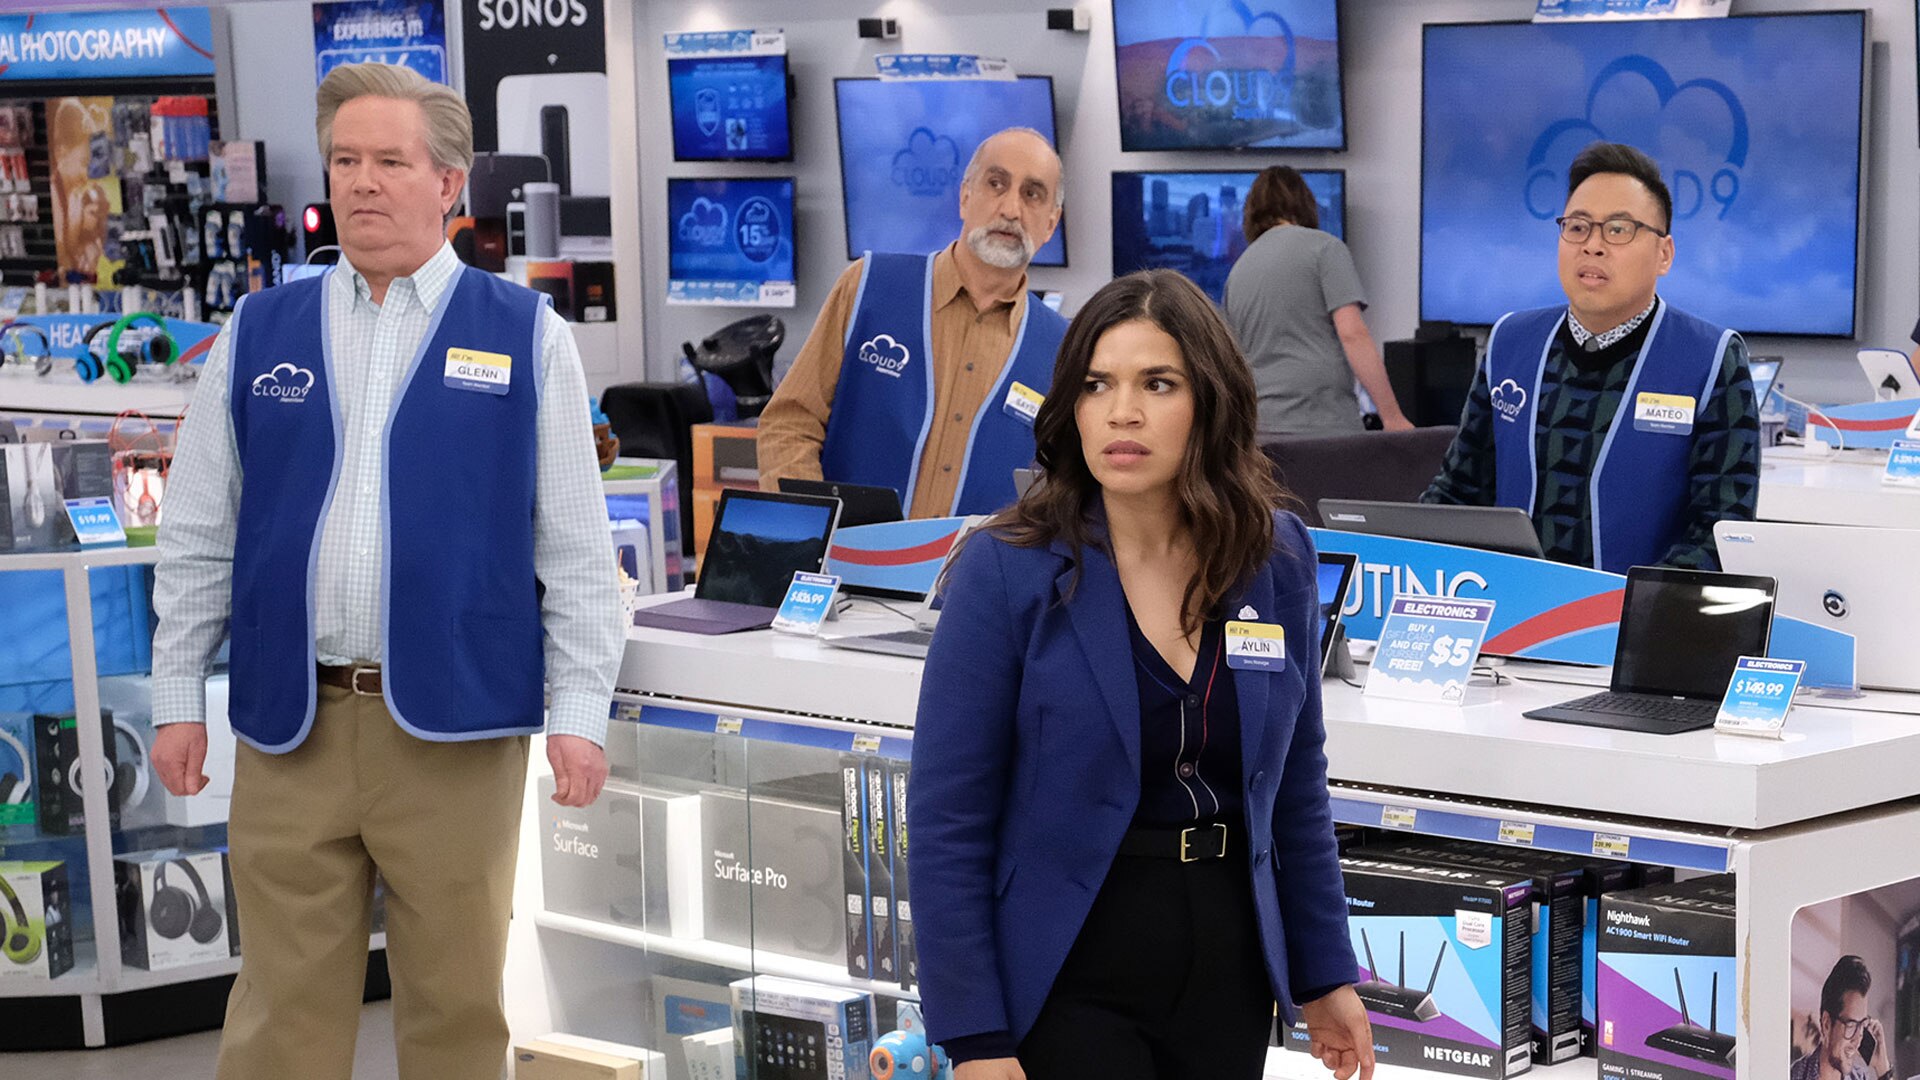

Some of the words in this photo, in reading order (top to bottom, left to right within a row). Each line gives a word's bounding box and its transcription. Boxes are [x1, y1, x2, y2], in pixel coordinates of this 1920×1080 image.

[478, 0, 588, 30] SONOS
[333, 21, 406, 41] EXPERIENCE
[20, 27, 167, 62] PHOTOGRAPHY
[1524, 168, 1740, 221] CD9
[739, 223, 760, 246] 15
[858, 351, 905, 372] CLOUD9
[457, 365, 499, 379] GLENN
[252, 384, 310, 397] CLOUD9
[1490, 395, 1521, 417] CLOUD9
[1645, 408, 1683, 420] MATEO
[1403, 602, 1478, 618] ELECTRONICS
[1386, 630, 1405, 639] GIFT
[1407, 631, 1433, 641] CARD
[1407, 623, 1427, 632] BUY
[1428, 624, 1435, 633] A
[1241, 641, 1271, 653] AYLIN
[1389, 640, 1410, 650] AND
[1411, 641, 1431, 651] GET
[1428, 634, 1474, 668] $5
[1388, 658, 1424, 672] FREE!
[1746, 661, 1794, 671] ELECTRONICS
[1735, 679, 1785, 696] $149.99
[562, 819, 589, 832] Microsoft
[553, 832, 599, 859] Surface
[714, 859, 763, 885] Surface
[765, 866, 788, 889] Pro
[1338, 858, 1474, 880] NETGEAR
[1352, 897, 1375, 908] Router
[1606, 910, 1651, 926] Nighthawk
[1606, 926, 1632, 938] AC1900
[1633, 930, 1652, 941] Smart
[1653, 933, 1667, 943] WiFi
[1668, 935, 1690, 947] Router
[1423, 1045, 1494, 1068] NETGEAR
[1602, 1063, 1625, 1074] GAMING
[1630, 1068, 1663, 1080] STREAMING
